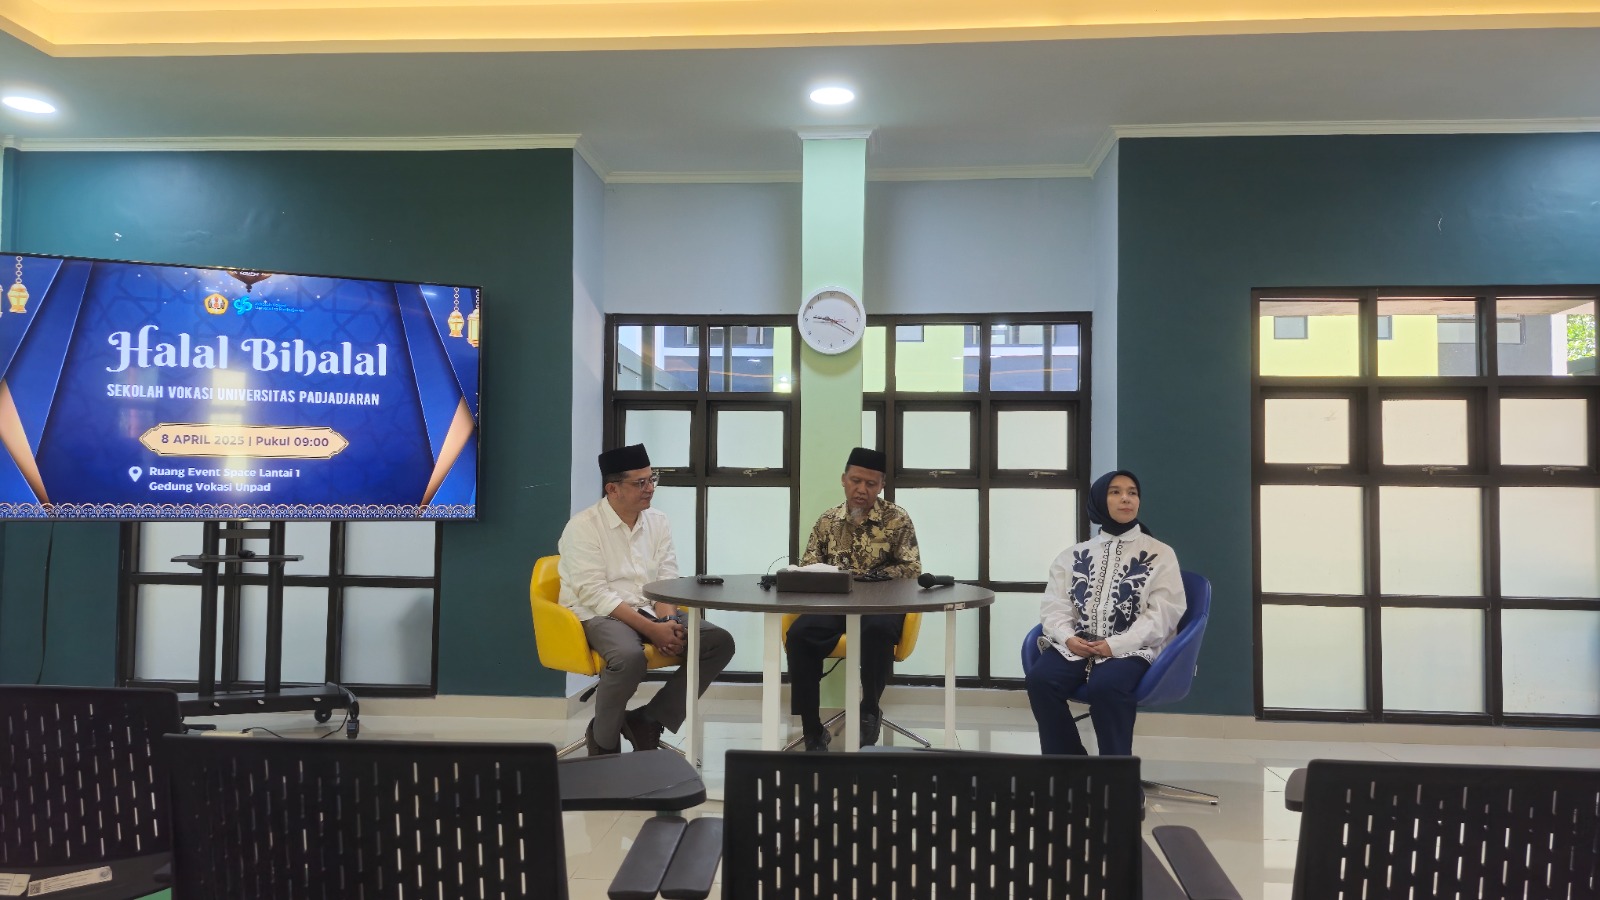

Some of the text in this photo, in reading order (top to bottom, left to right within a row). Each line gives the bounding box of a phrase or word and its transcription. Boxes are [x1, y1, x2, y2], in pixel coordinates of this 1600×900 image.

[106, 324, 387, 376] Halal Bihalal
[107, 383, 380, 405] SEKOLAH VOKASI UNIVERSITAS PADJADJARAN
[161, 434, 169, 444] 8
[173, 434, 211, 445] APRIL
[214, 435, 245, 446] 2025
[256, 436, 290, 446] Pukul
[294, 437, 329, 447] 09:00
[149, 466, 300, 478] Ruang Event Space Lantai 1
[149, 481, 271, 493] Gedung Vokasi Unpad
